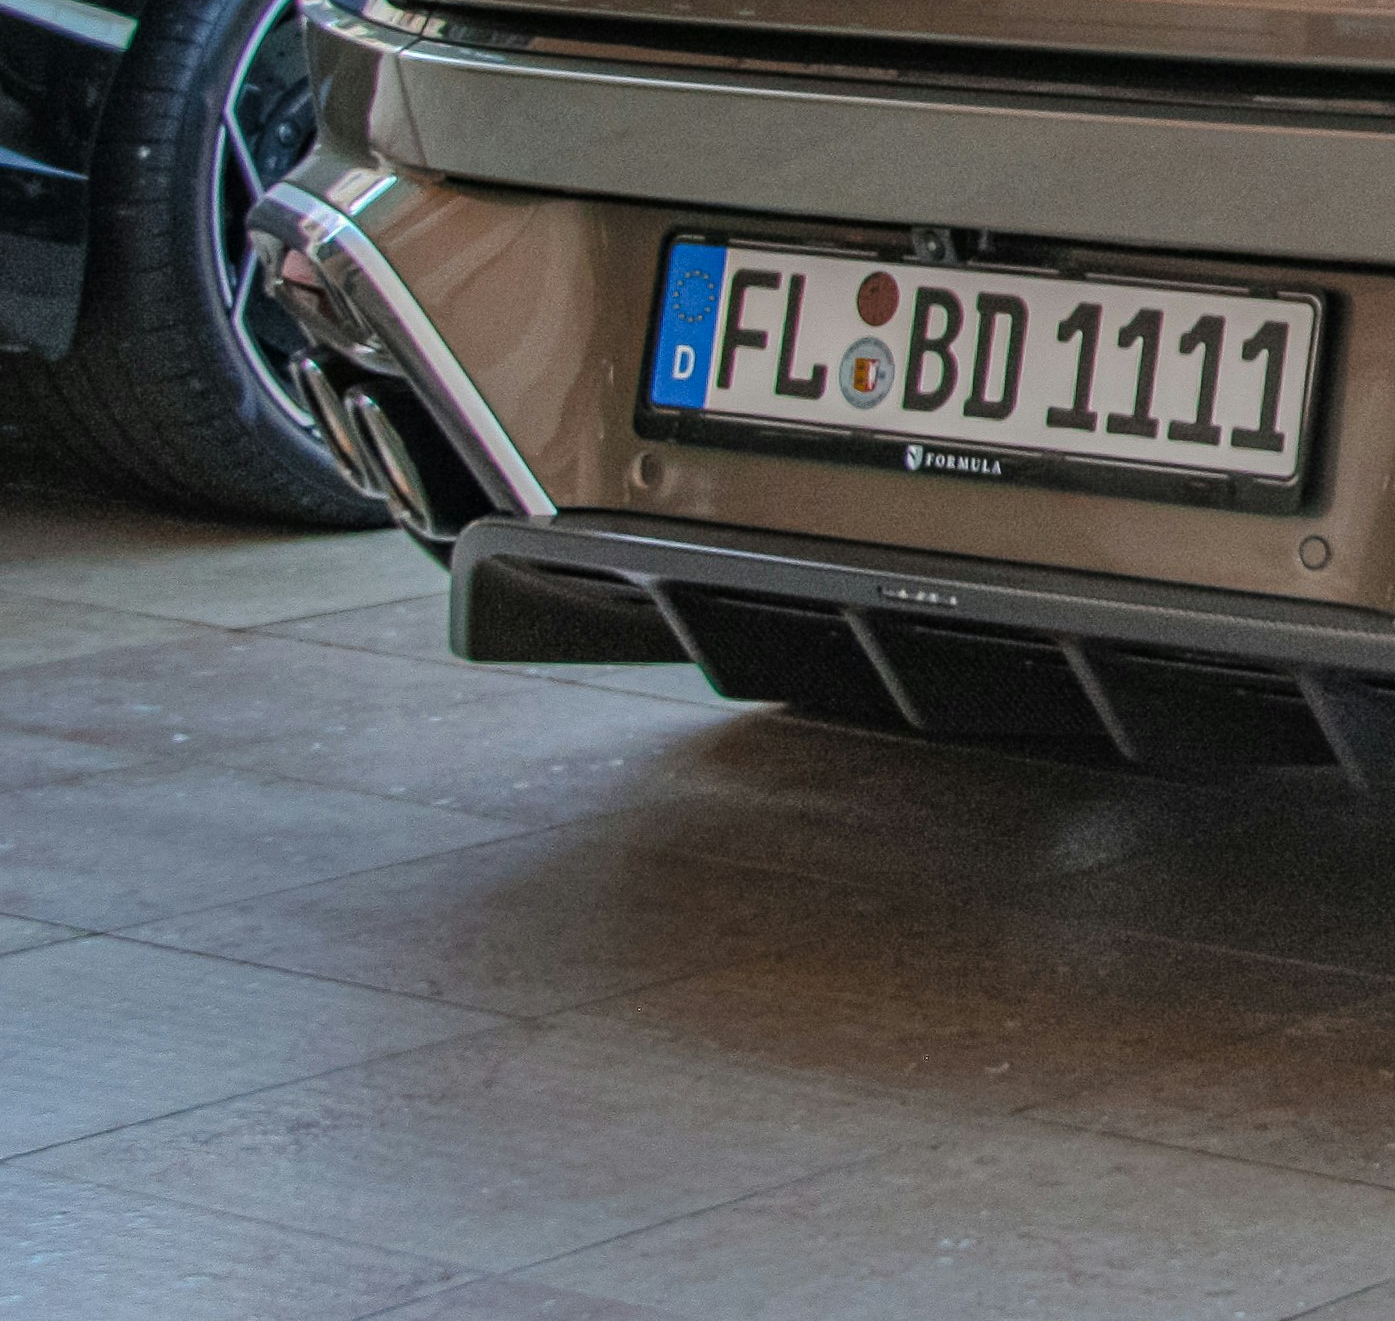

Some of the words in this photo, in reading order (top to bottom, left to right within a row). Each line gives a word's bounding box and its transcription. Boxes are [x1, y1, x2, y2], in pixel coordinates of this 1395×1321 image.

[672, 344, 696, 380] D
[717, 268, 828, 400] FL
[903, 286, 1029, 420] BD
[1046, 302, 1289, 452] 1111
[925, 452, 1002, 475] FORMULA
